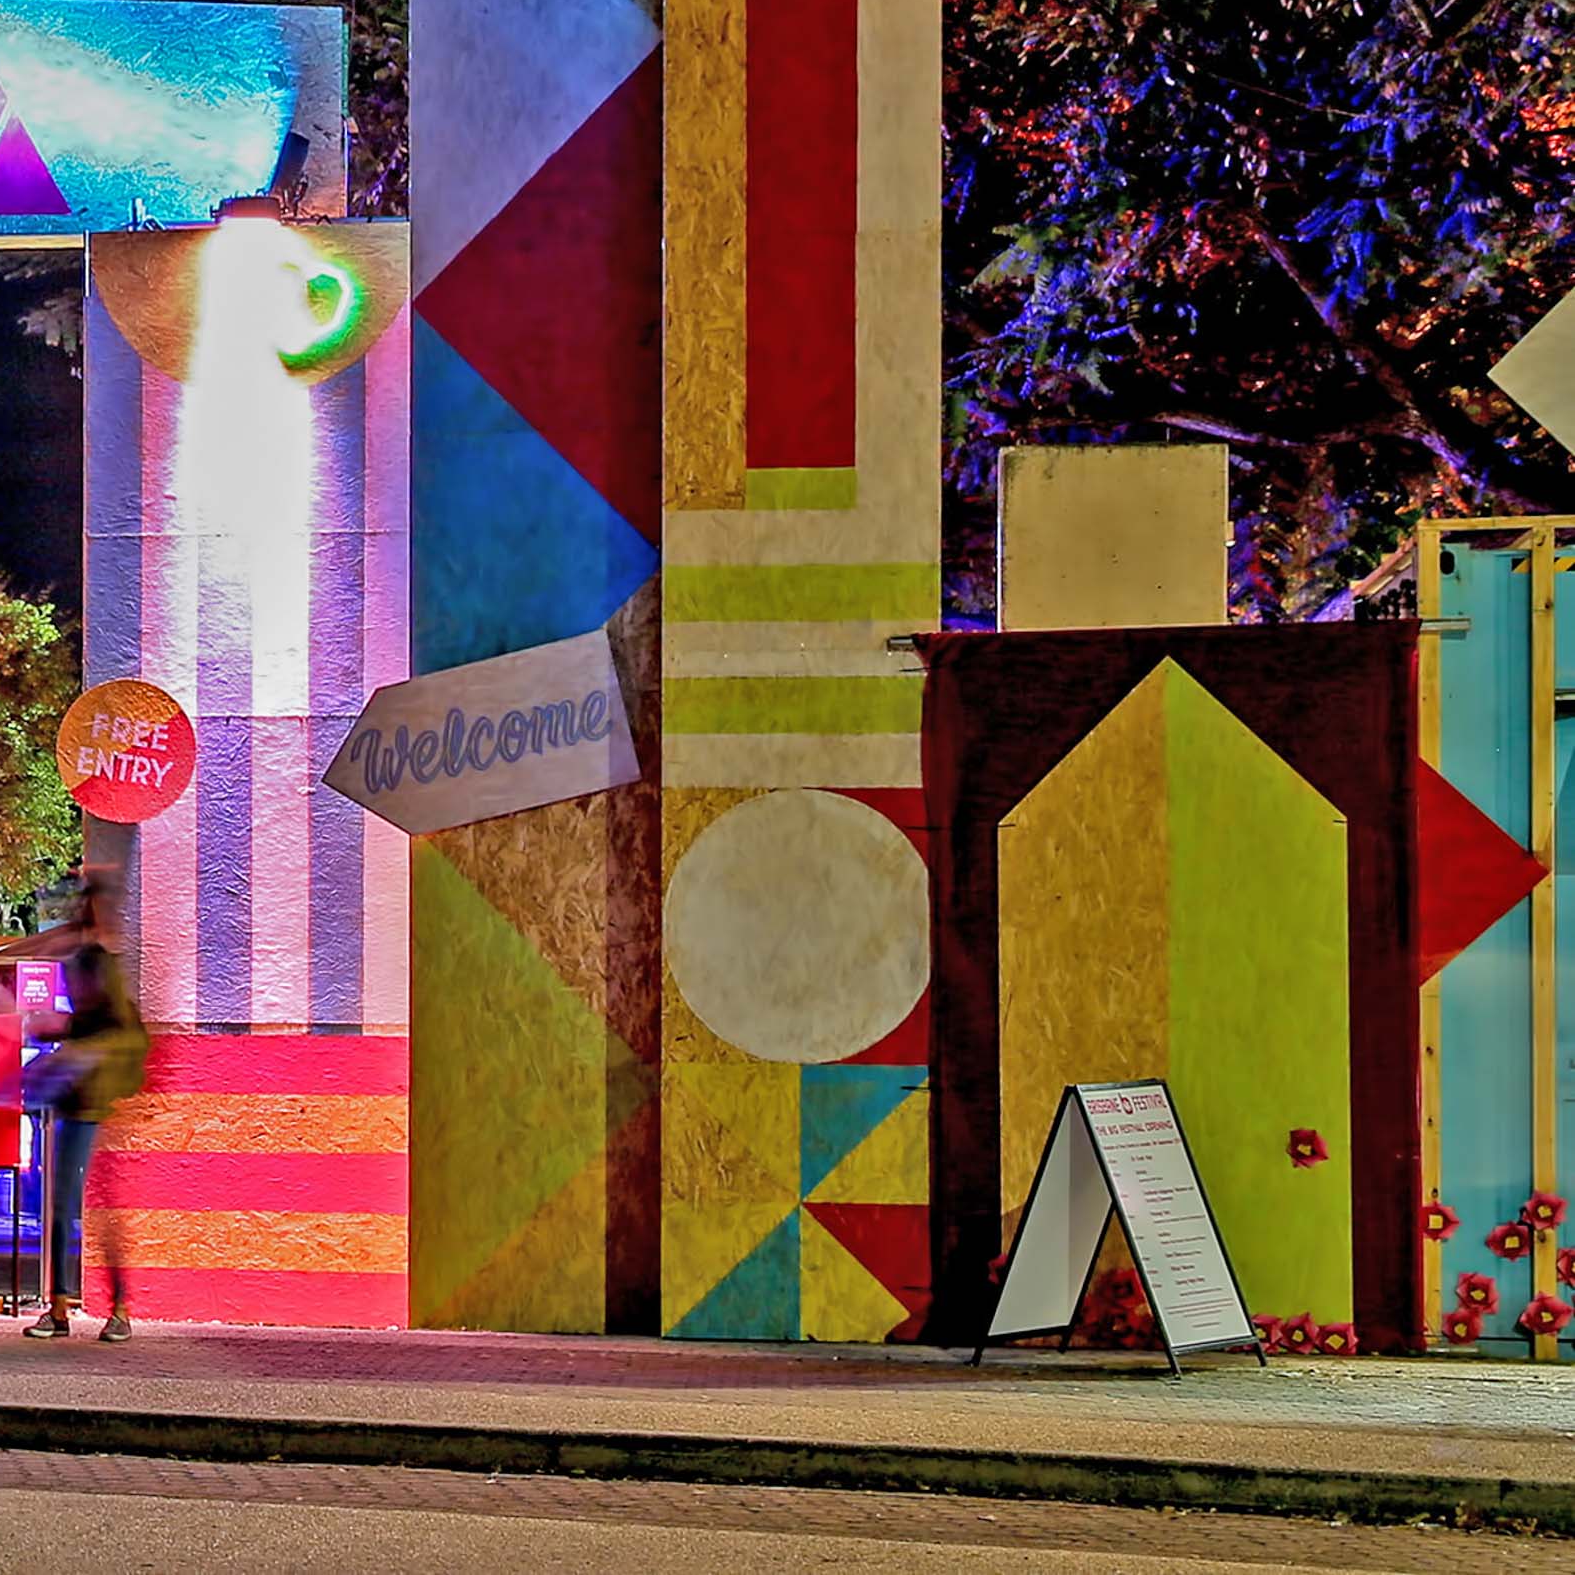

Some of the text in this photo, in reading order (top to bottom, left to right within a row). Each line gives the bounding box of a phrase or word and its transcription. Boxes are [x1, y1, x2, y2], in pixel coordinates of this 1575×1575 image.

[91, 713, 169, 752] FREE
[350, 689, 615, 795] Welcome
[76, 745, 174, 788] ENTRY
